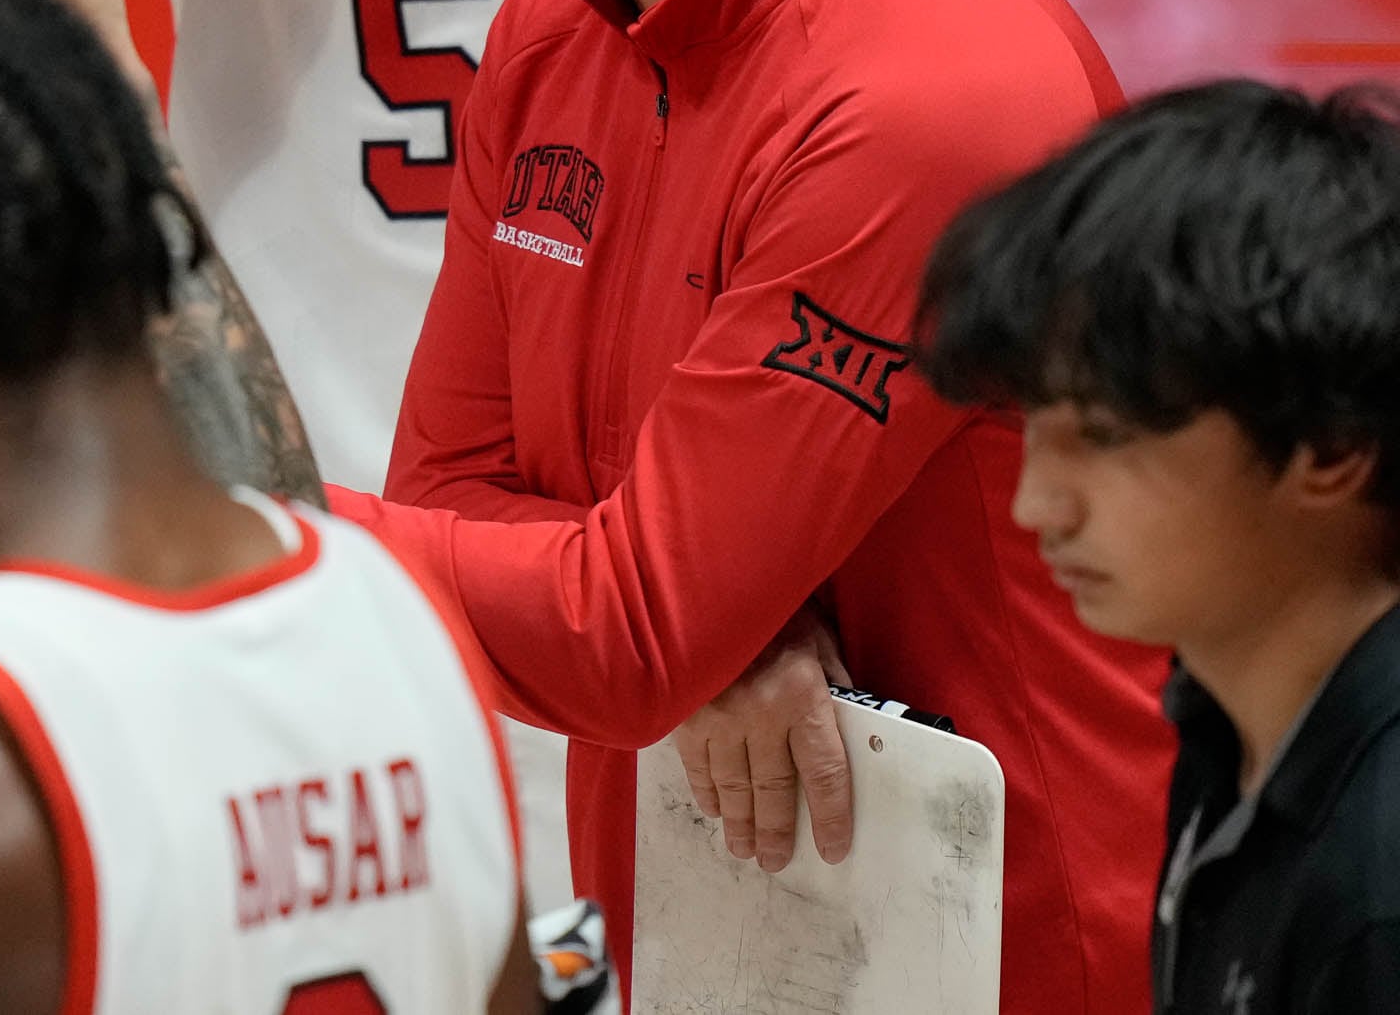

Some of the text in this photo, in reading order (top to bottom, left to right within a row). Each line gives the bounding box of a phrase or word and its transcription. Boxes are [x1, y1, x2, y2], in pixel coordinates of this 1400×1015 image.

[493, 221, 584, 267] BASKETBALL
[503, 144, 604, 244] UTAH
[225, 757, 430, 930] AUSAR
